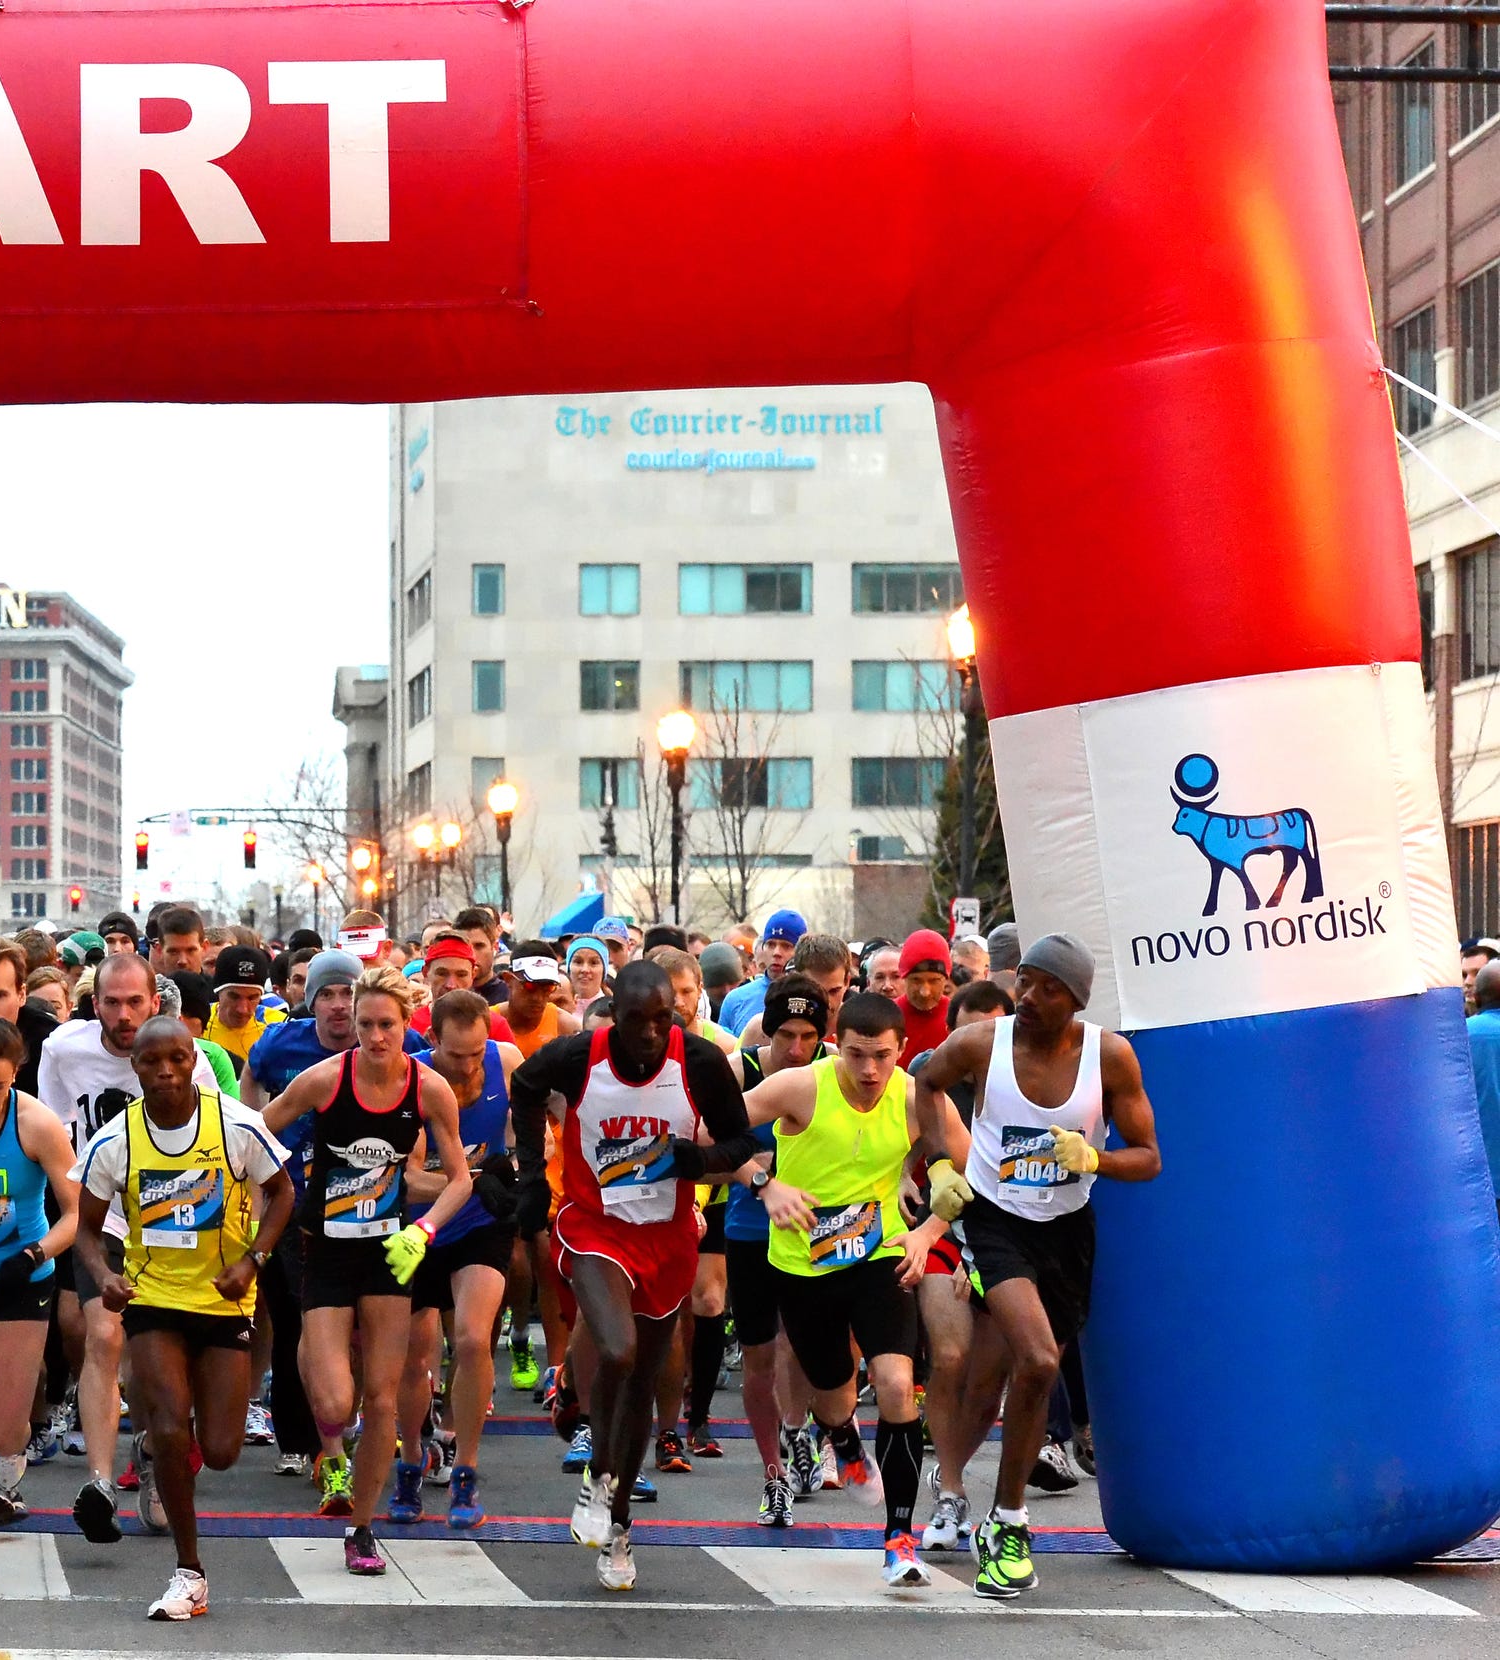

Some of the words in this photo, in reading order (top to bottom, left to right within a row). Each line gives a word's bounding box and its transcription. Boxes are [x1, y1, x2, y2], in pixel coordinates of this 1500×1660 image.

[555, 405, 612, 439] The
[1131, 925, 1231, 966] novo
[1244, 896, 1387, 951] nordisk
[348, 1144, 393, 1159] John's
[632, 1164, 647, 1180] 2
[145, 1179, 175, 1191] 2013
[171, 1204, 196, 1226] 13
[354, 1199, 377, 1219] 10
[833, 1236, 866, 1260] 176
